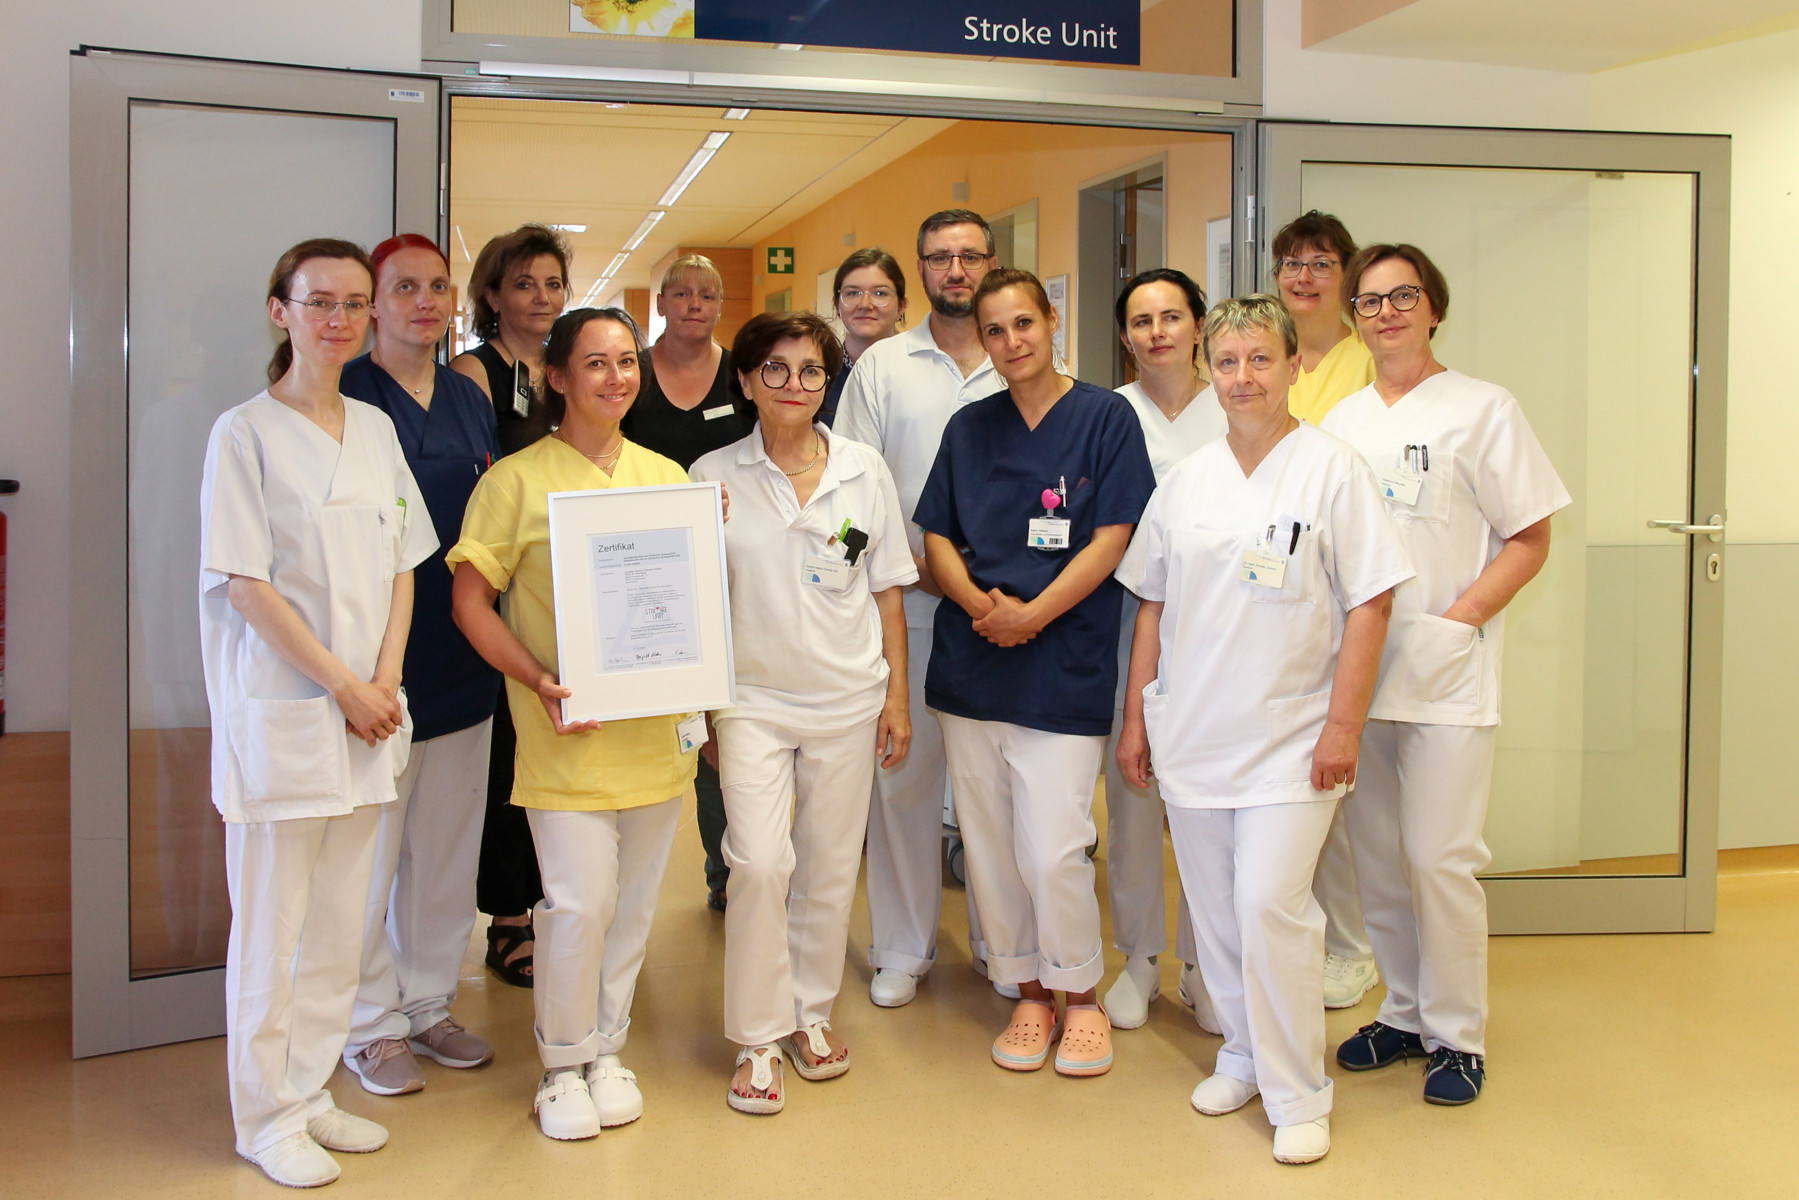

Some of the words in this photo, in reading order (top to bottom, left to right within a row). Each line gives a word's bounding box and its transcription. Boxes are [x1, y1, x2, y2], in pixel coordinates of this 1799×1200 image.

[964, 16, 1051, 45] Stroke
[1061, 22, 1118, 49] Unit
[597, 542, 635, 552] Zertifikat
